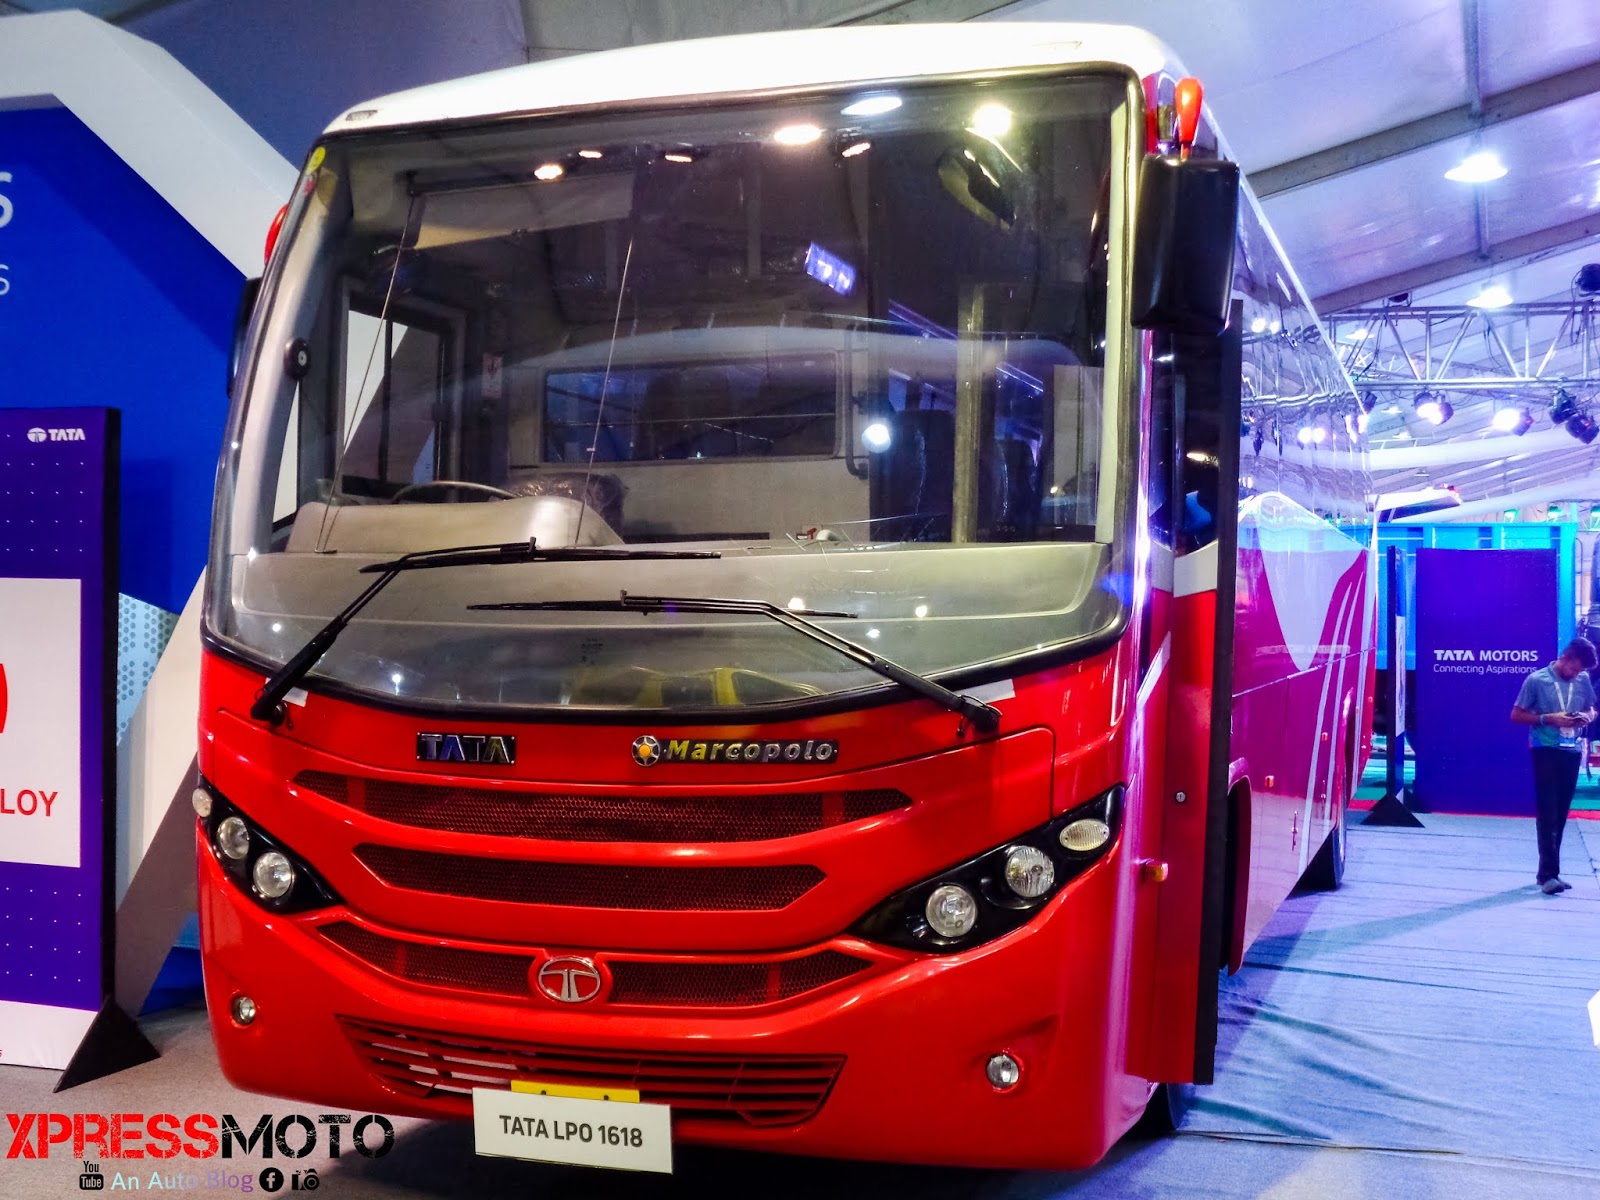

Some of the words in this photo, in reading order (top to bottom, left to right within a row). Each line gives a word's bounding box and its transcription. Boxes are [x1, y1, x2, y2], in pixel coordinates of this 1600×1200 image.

[47, 428, 86, 441] TATA
[1433, 649, 1475, 661] TATA
[1479, 650, 1539, 662] MOTORS
[1433, 663, 1484, 675] Connecting
[1485, 664, 1538, 675] Aspirations
[420, 733, 511, 765] TATA
[667, 739, 833, 762] Marcopolo
[0, 788, 59, 817] LOY
[499, 1115, 549, 1138] TATA
[553, 1120, 593, 1143] LPO
[597, 1125, 643, 1148] 1618
